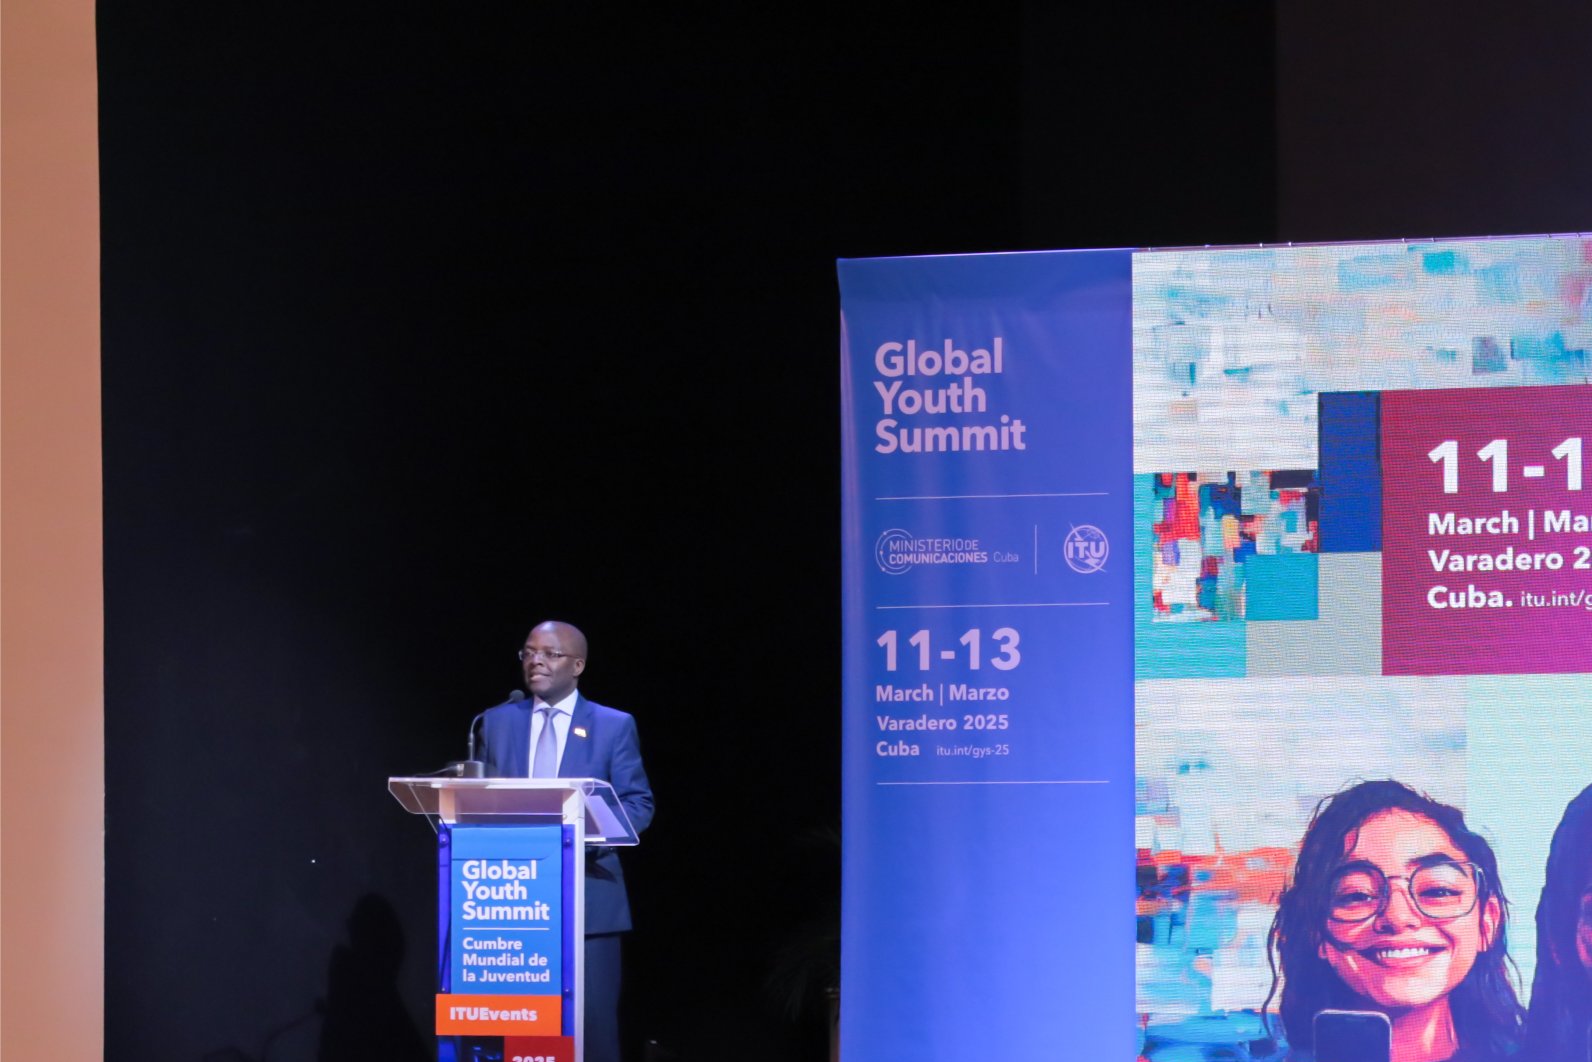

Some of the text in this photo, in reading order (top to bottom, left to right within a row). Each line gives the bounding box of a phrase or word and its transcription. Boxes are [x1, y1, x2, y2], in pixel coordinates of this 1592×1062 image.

[875, 338, 1003, 377] Global
[874, 376, 987, 415] Youth
[875, 415, 1026, 454] Summit
[1429, 510, 1518, 535] March
[889, 551, 1019, 565] COMUNICACIONES Cuba
[1428, 547, 1563, 571] Varadero
[1428, 585, 1512, 608] Cuba.
[878, 627, 1021, 670] 11-13
[876, 683, 934, 701] March
[949, 684, 1009, 700] Marzo
[877, 714, 1009, 730] Varadero 2025
[876, 740, 1010, 758] Cuba itu.int/gys-25
[462, 860, 537, 881] Global
[461, 881, 528, 901] Youth
[462, 902, 550, 921] Summit
[463, 937, 522, 950] Cumbre
[463, 953, 547, 966] Mundial de
[463, 969, 550, 982] la Juventud
[450, 1007, 537, 1021] ITUEvents
